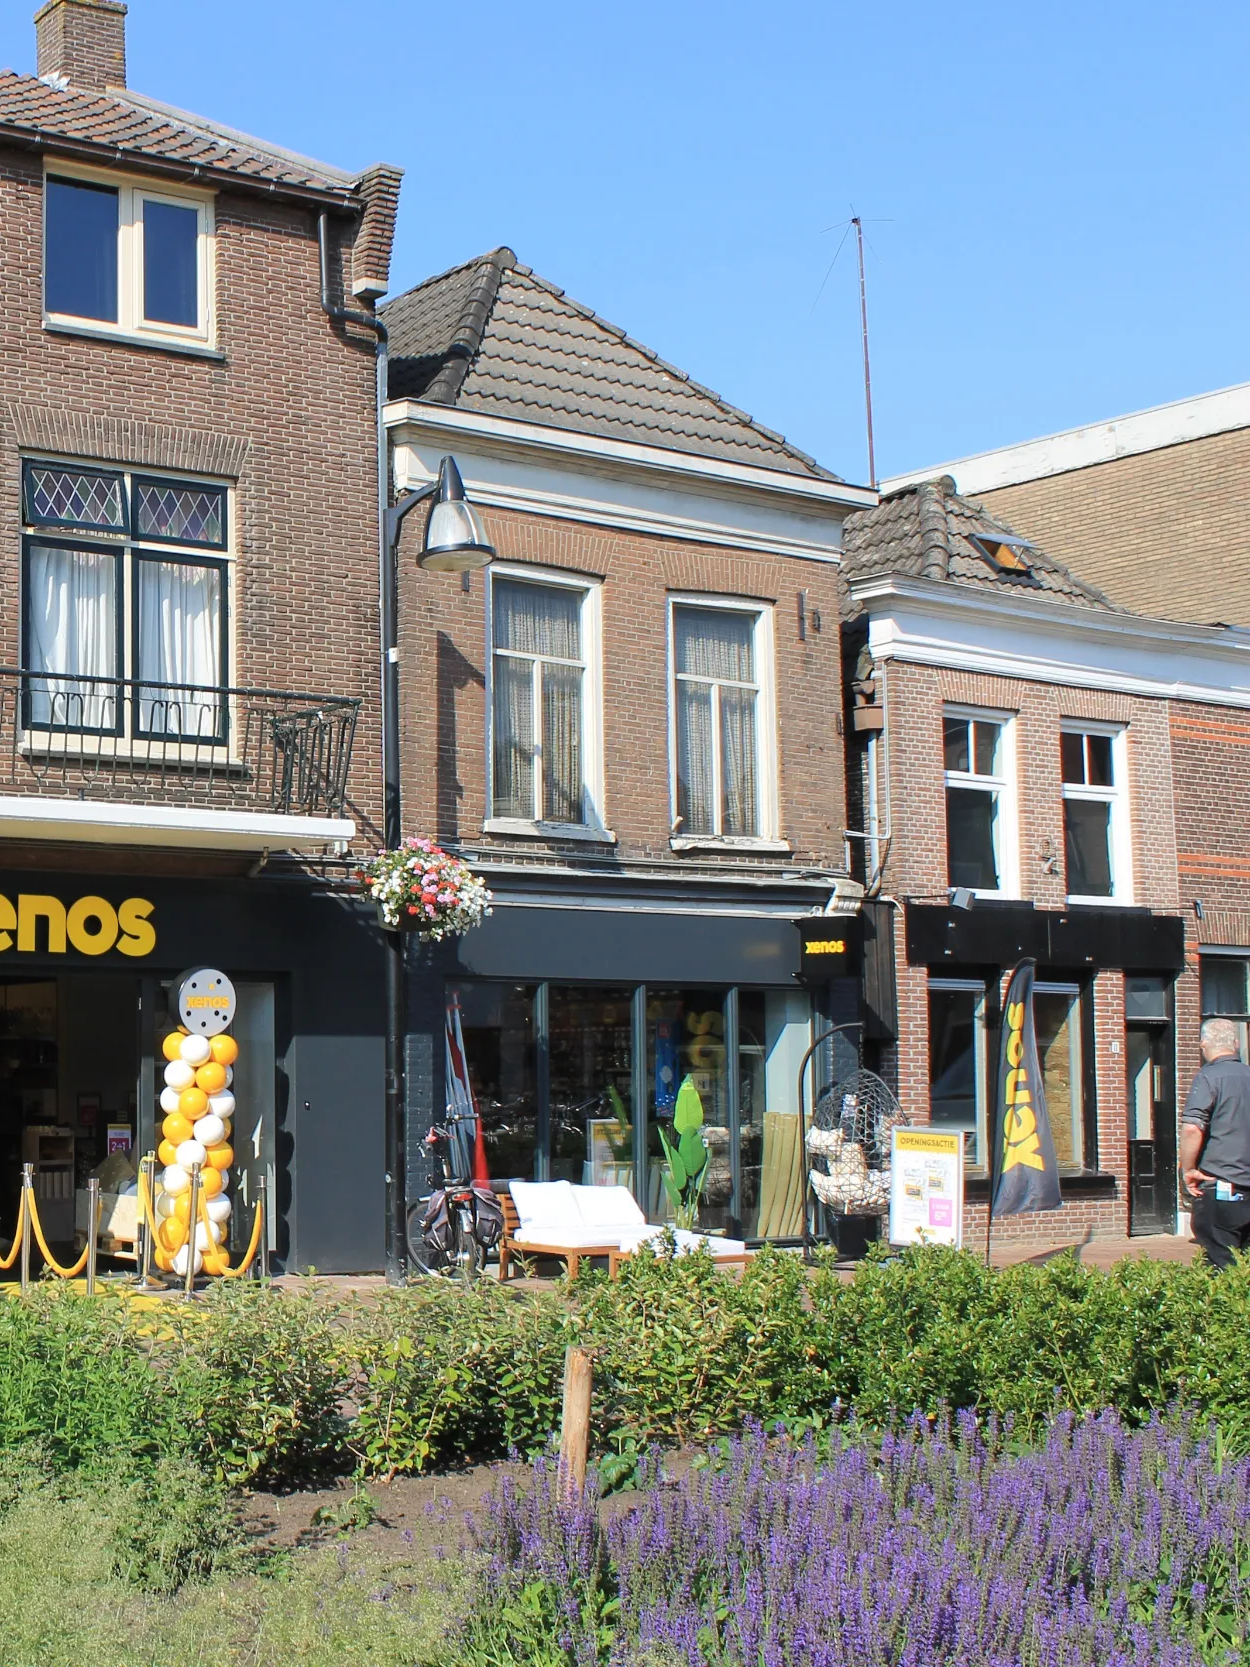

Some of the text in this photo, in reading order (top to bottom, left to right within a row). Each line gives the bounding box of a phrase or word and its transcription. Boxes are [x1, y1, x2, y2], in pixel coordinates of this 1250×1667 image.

[805, 940, 845, 954] xenos
[186, 996, 229, 1009] xenos
[1002, 1001, 1045, 1173] xenos
[900, 1137, 955, 1149] OPENINGSACTIE
